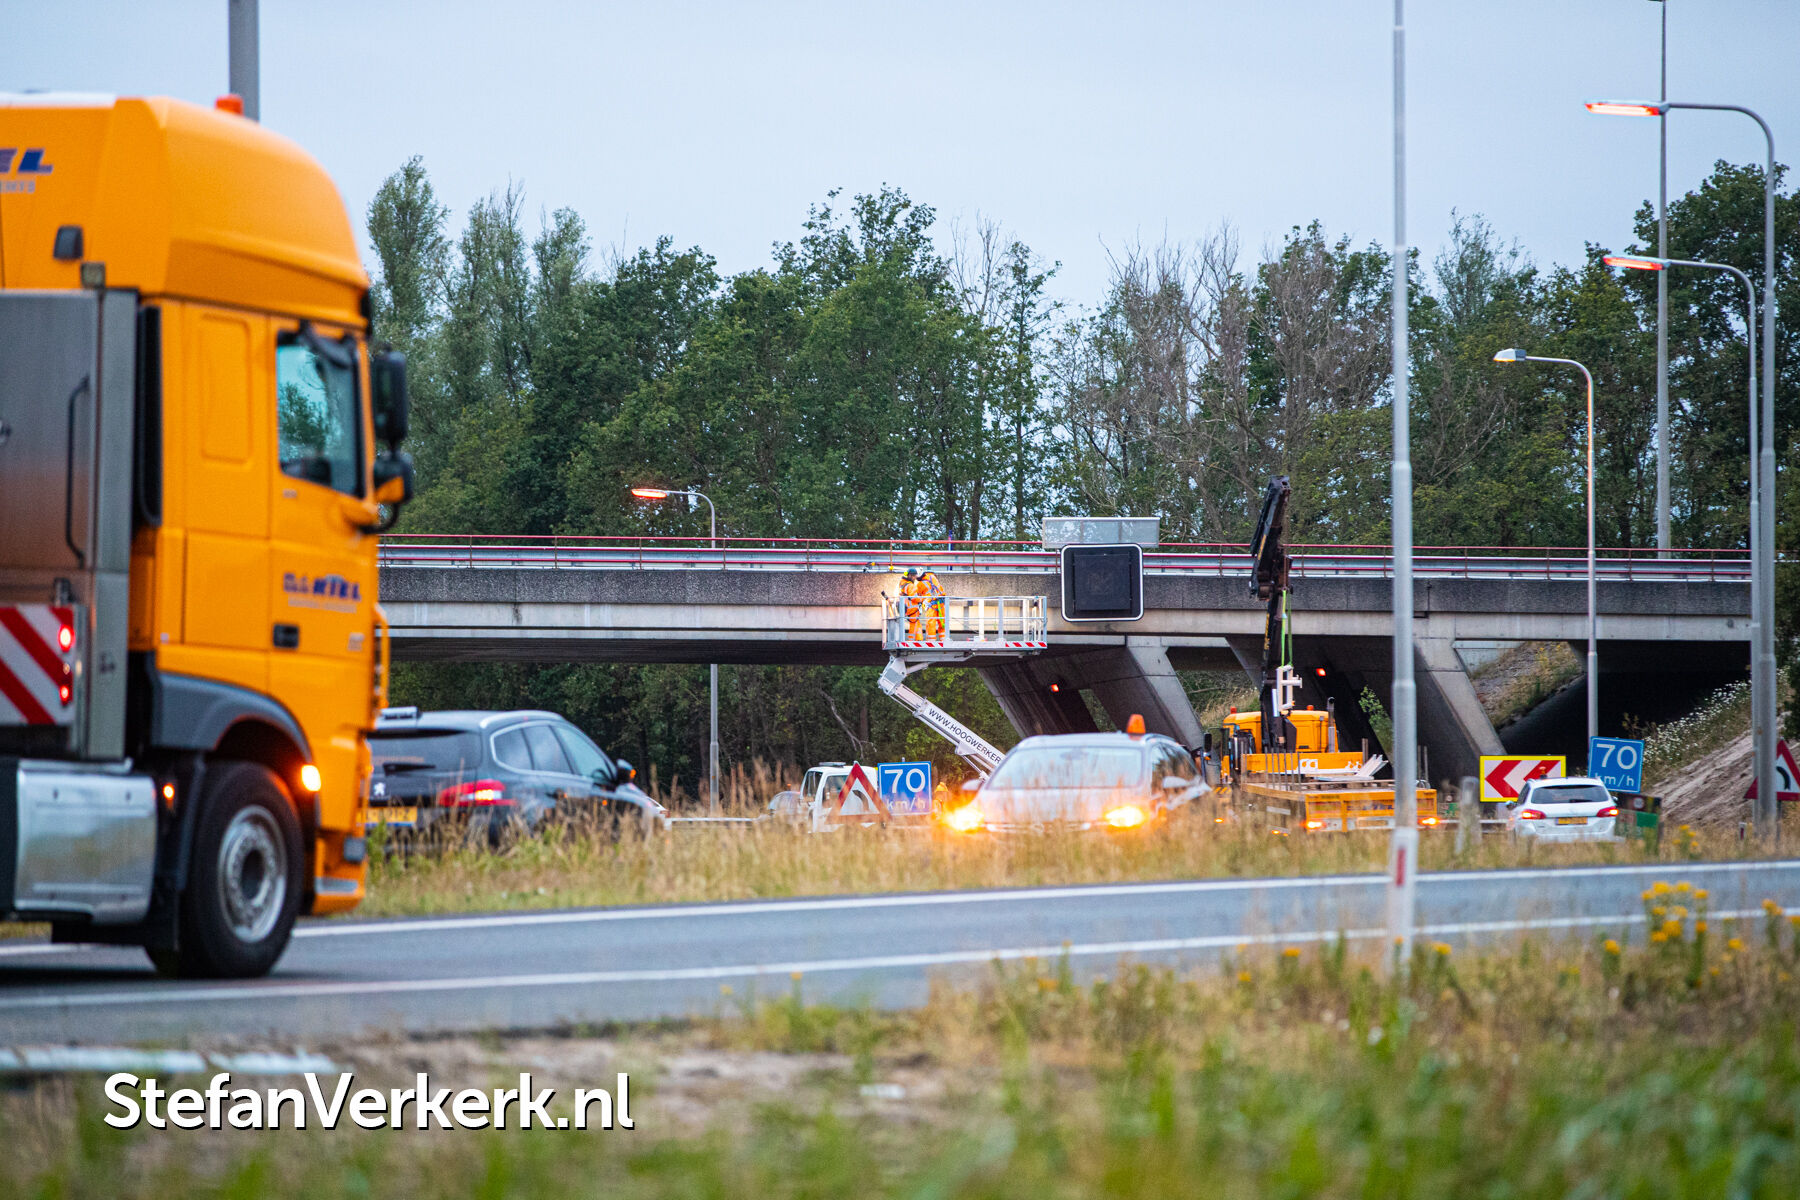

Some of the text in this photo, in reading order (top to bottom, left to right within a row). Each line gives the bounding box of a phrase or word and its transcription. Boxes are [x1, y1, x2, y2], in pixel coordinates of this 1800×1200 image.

[928, 708, 1002, 764] WWW.HOOGWERKER
[1596, 743, 1637, 770] 70
[884, 768, 926, 793] 70
[886, 797, 926, 811] km/h
